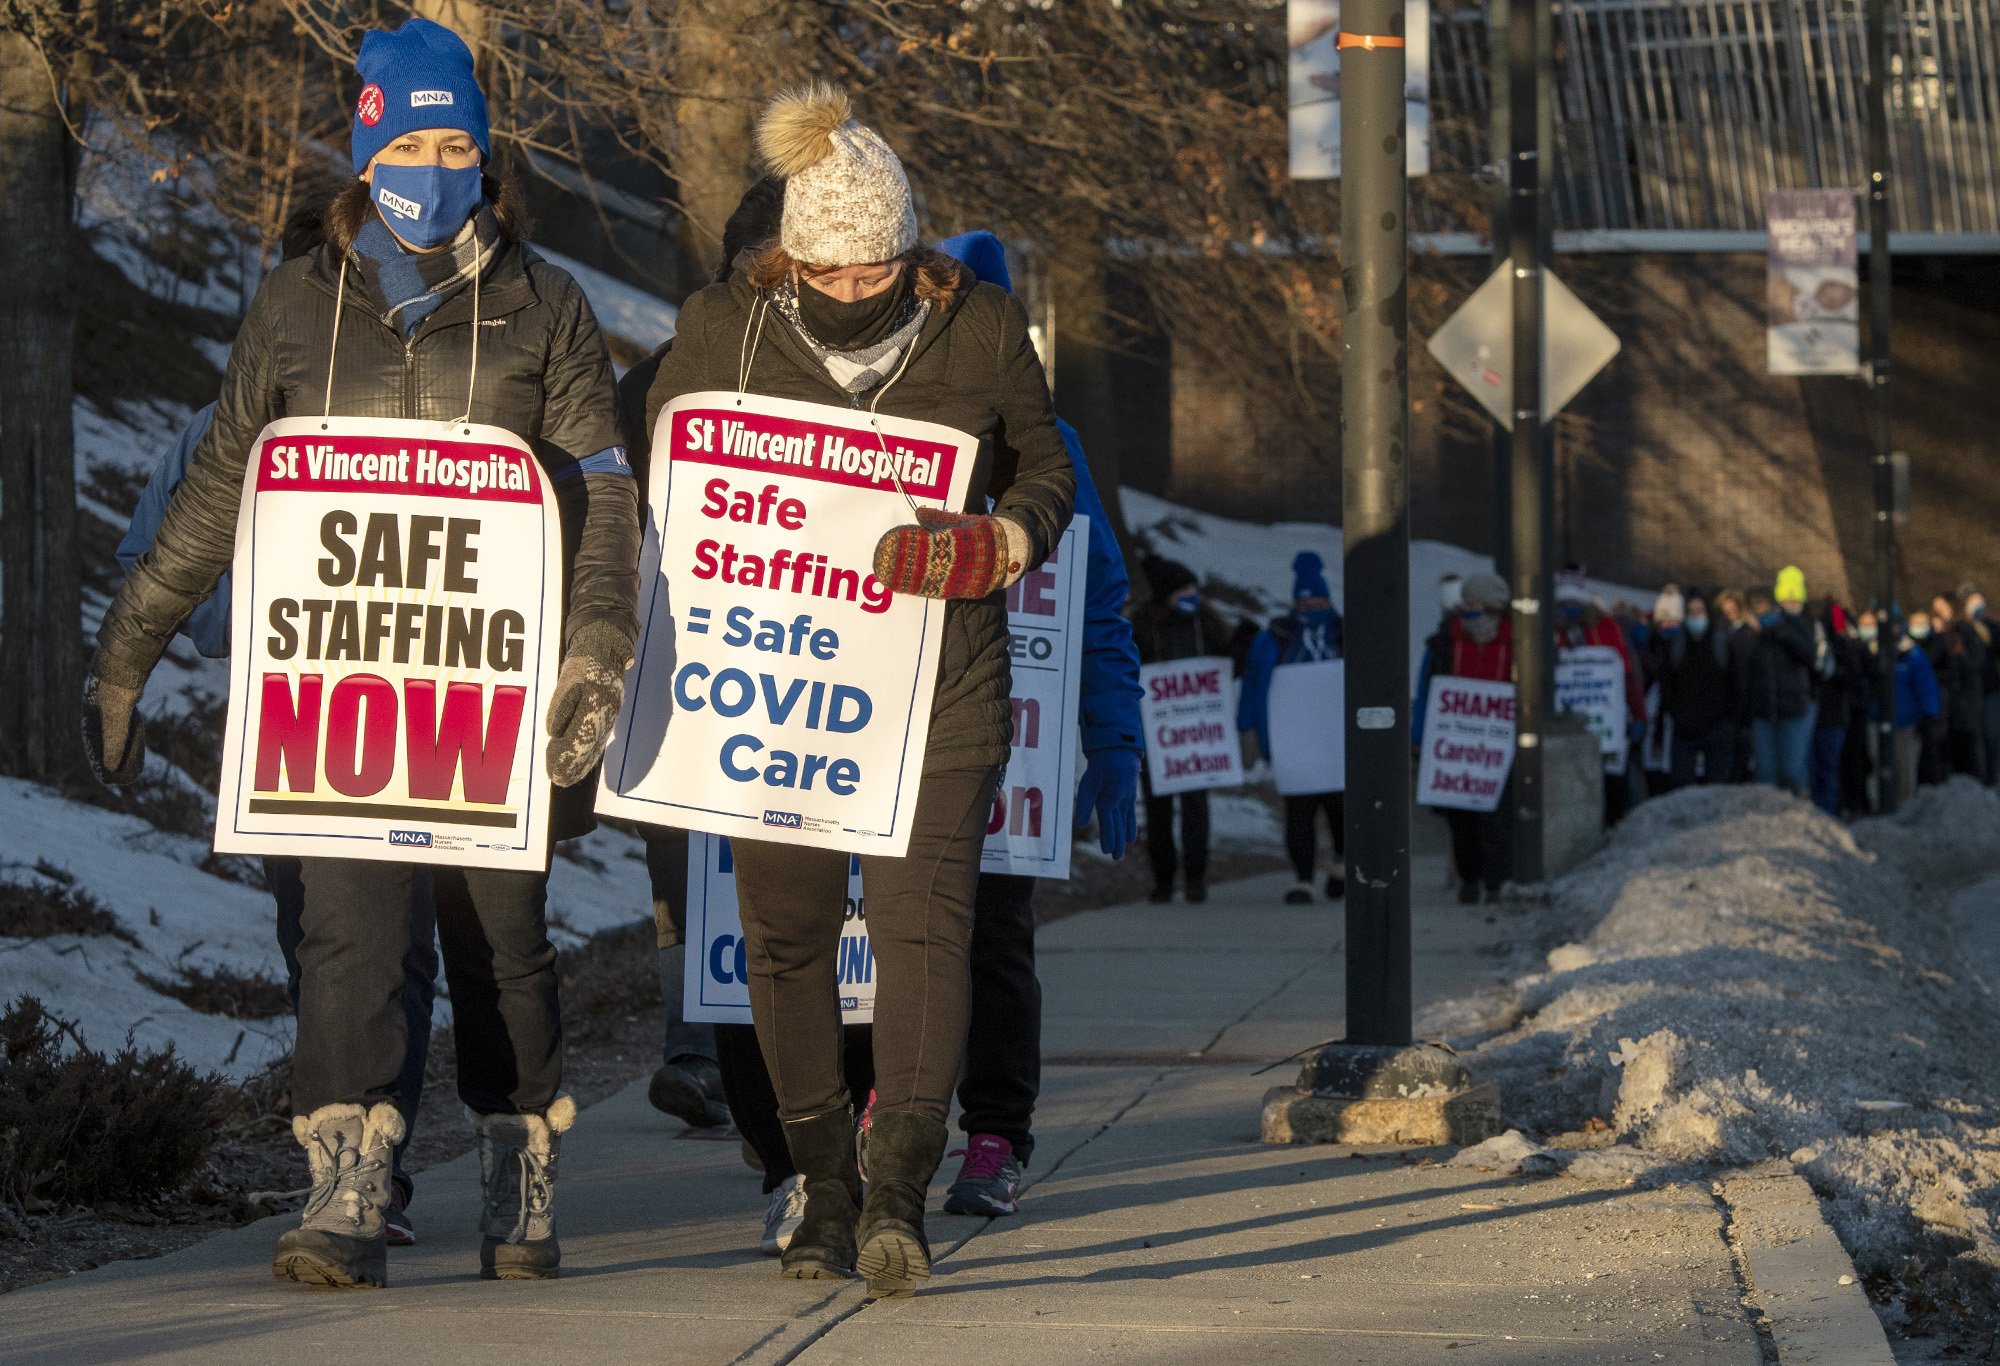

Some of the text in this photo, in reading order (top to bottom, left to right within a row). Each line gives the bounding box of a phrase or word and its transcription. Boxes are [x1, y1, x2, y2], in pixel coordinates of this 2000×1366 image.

[413, 92, 450, 104] MNA
[382, 192, 415, 216] MNA
[270, 444, 531, 494] St Vincent Hospital
[685, 417, 942, 487] St Vincent Hospital
[700, 477, 807, 531] Safe
[317, 509, 482, 594] SAFE
[691, 538, 894, 614] Staffing
[266, 597, 526, 672] STAFFING
[722, 605, 840, 661] Safe
[1008, 634, 1053, 661] EO
[673, 661, 873, 734] COVID
[1149, 668, 1222, 703] SHAME
[1439, 688, 1516, 721] SHAME
[253, 672, 528, 805] NOW
[1157, 720, 1225, 748] Carolyn
[718, 733, 861, 797] Care
[1163, 750, 1231, 780] Jackson
[1433, 737, 1505, 770] Carolyn
[1431, 768, 1498, 797] Jackson
[764, 812, 797, 825] MNA
[390, 831, 427, 844] MNA
